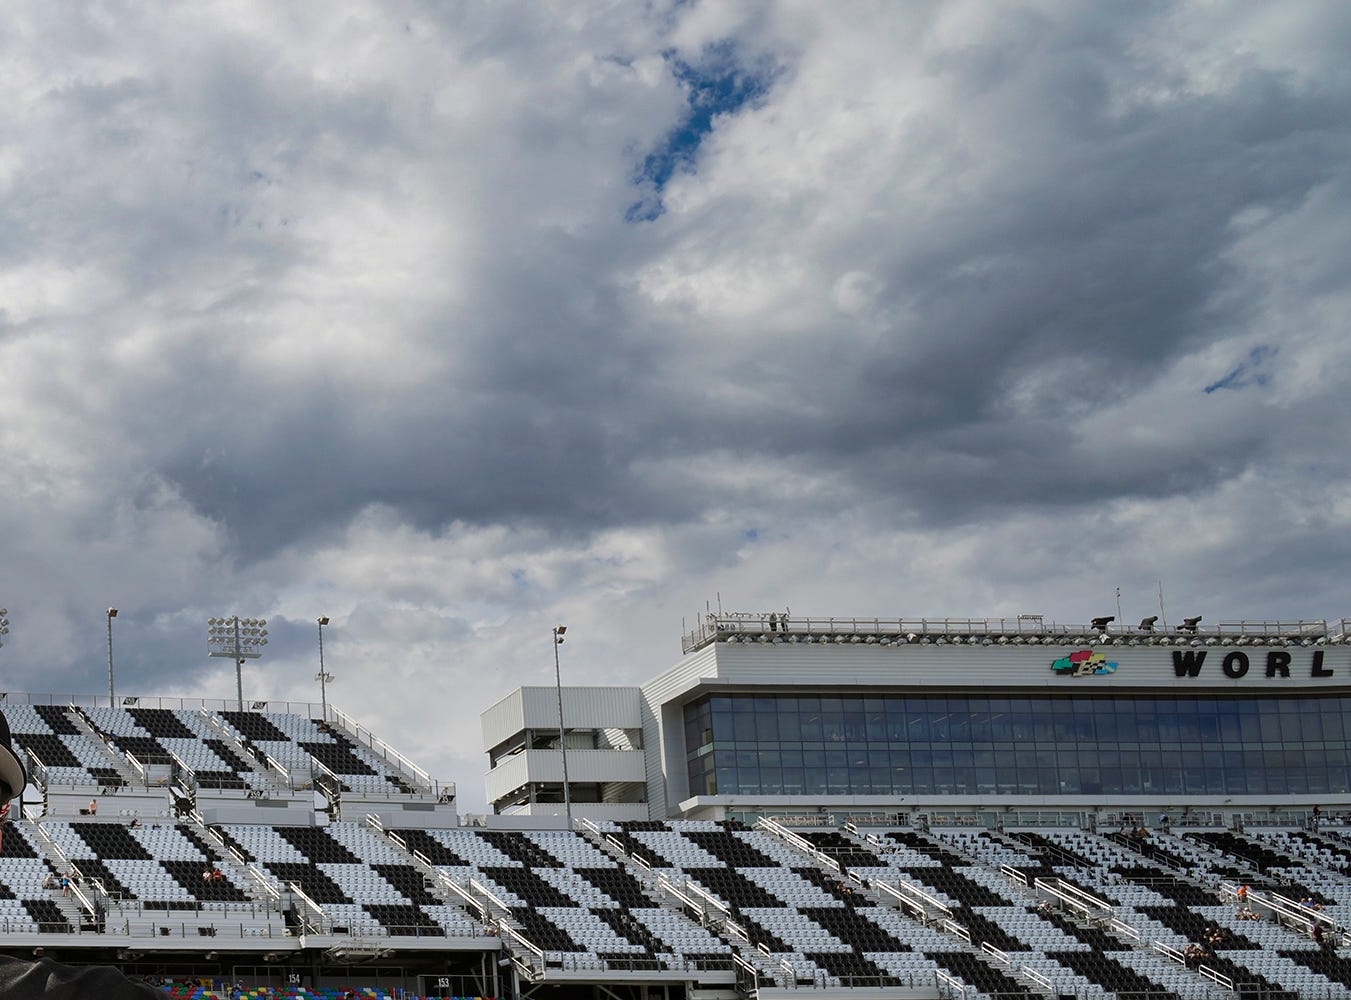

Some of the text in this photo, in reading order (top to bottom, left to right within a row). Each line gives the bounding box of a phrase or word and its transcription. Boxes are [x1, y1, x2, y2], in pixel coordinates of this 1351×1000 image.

[1172, 651, 1351, 679] WORL
[288, 974, 301, 984] 154
[438, 977, 449, 987] 153
